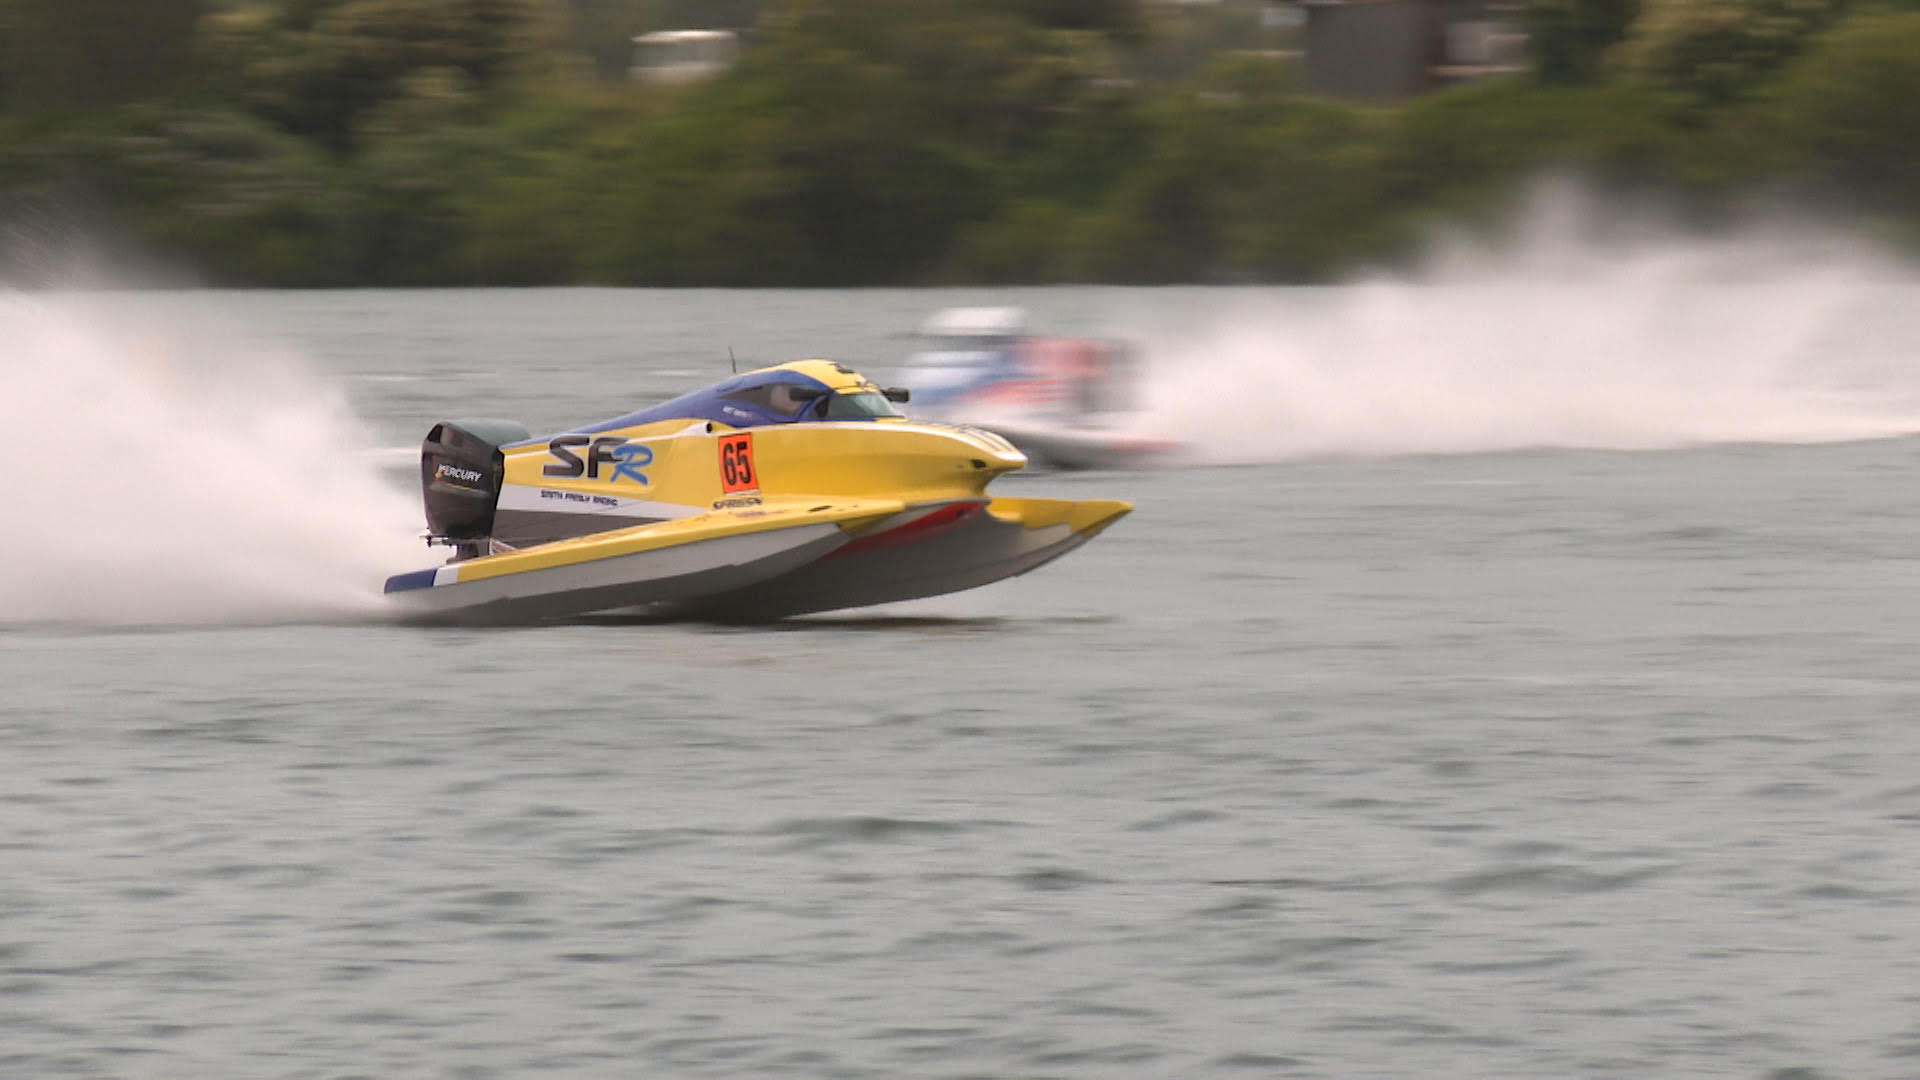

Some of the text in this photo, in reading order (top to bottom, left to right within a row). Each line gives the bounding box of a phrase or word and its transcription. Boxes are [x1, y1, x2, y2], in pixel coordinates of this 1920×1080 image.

[436, 463, 482, 482] MERCURY
[543, 435, 653, 485] SFR
[723, 441, 751, 486] 65
